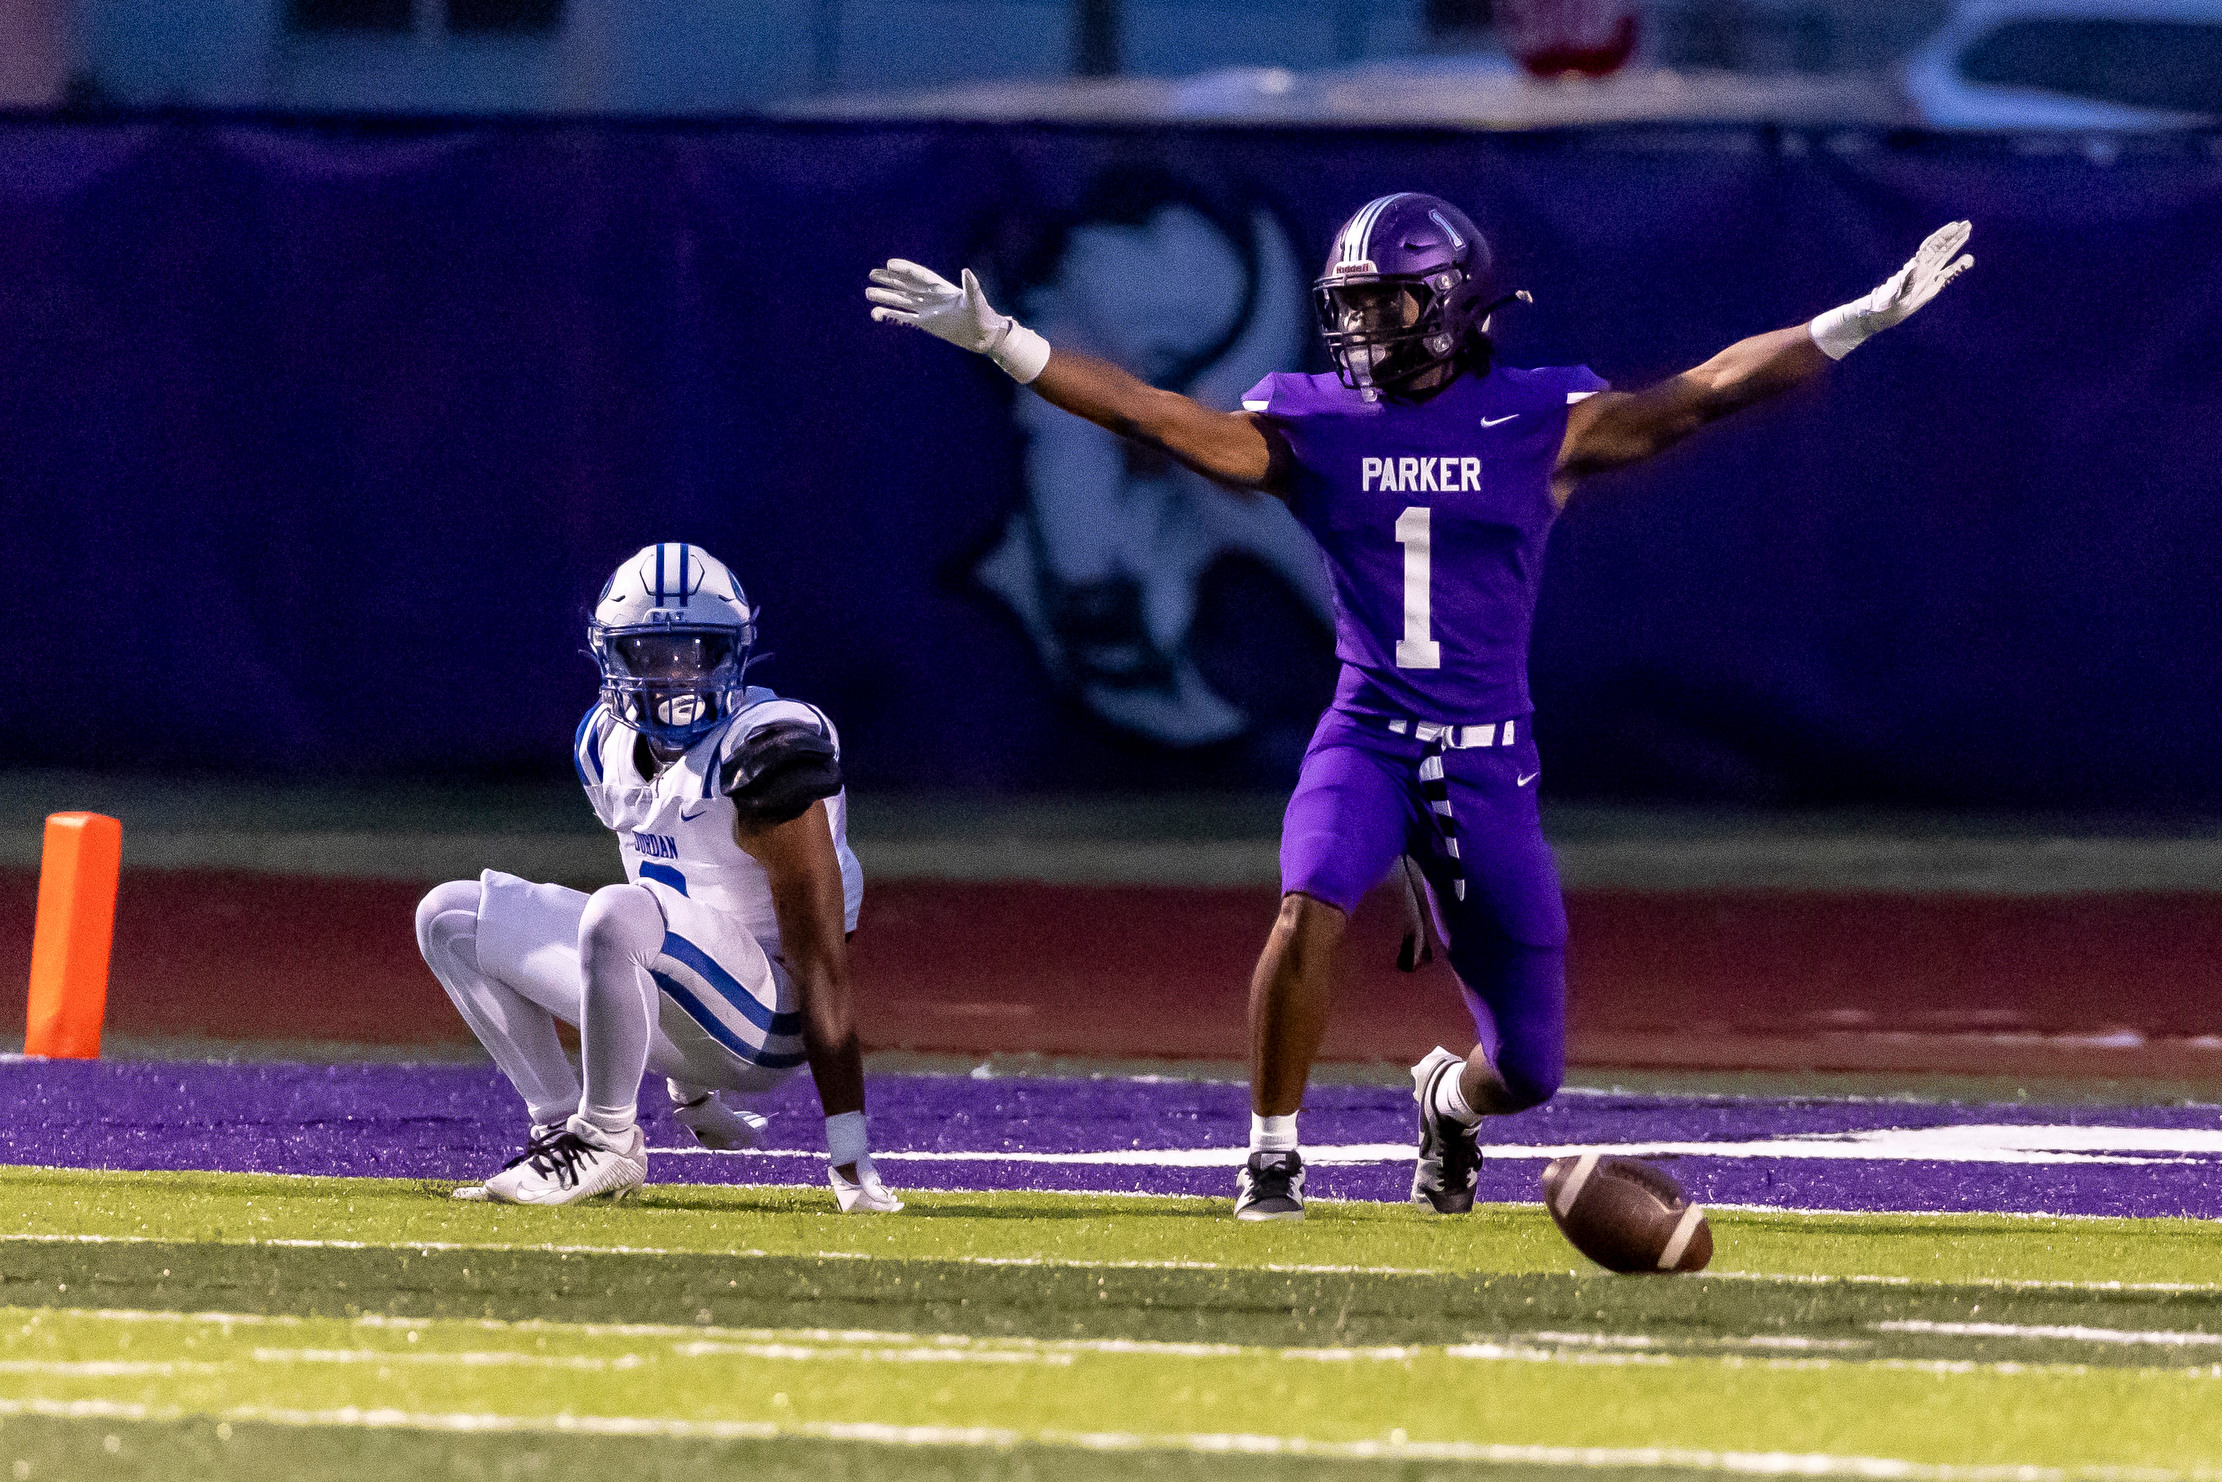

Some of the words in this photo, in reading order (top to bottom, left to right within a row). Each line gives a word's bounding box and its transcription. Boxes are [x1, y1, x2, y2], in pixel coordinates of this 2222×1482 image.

[1336, 263, 1370, 273] Riddell
[1362, 457, 1482, 492] PARKER
[1395, 506, 1441, 670] 1
[633, 831, 679, 860] JORDAN
